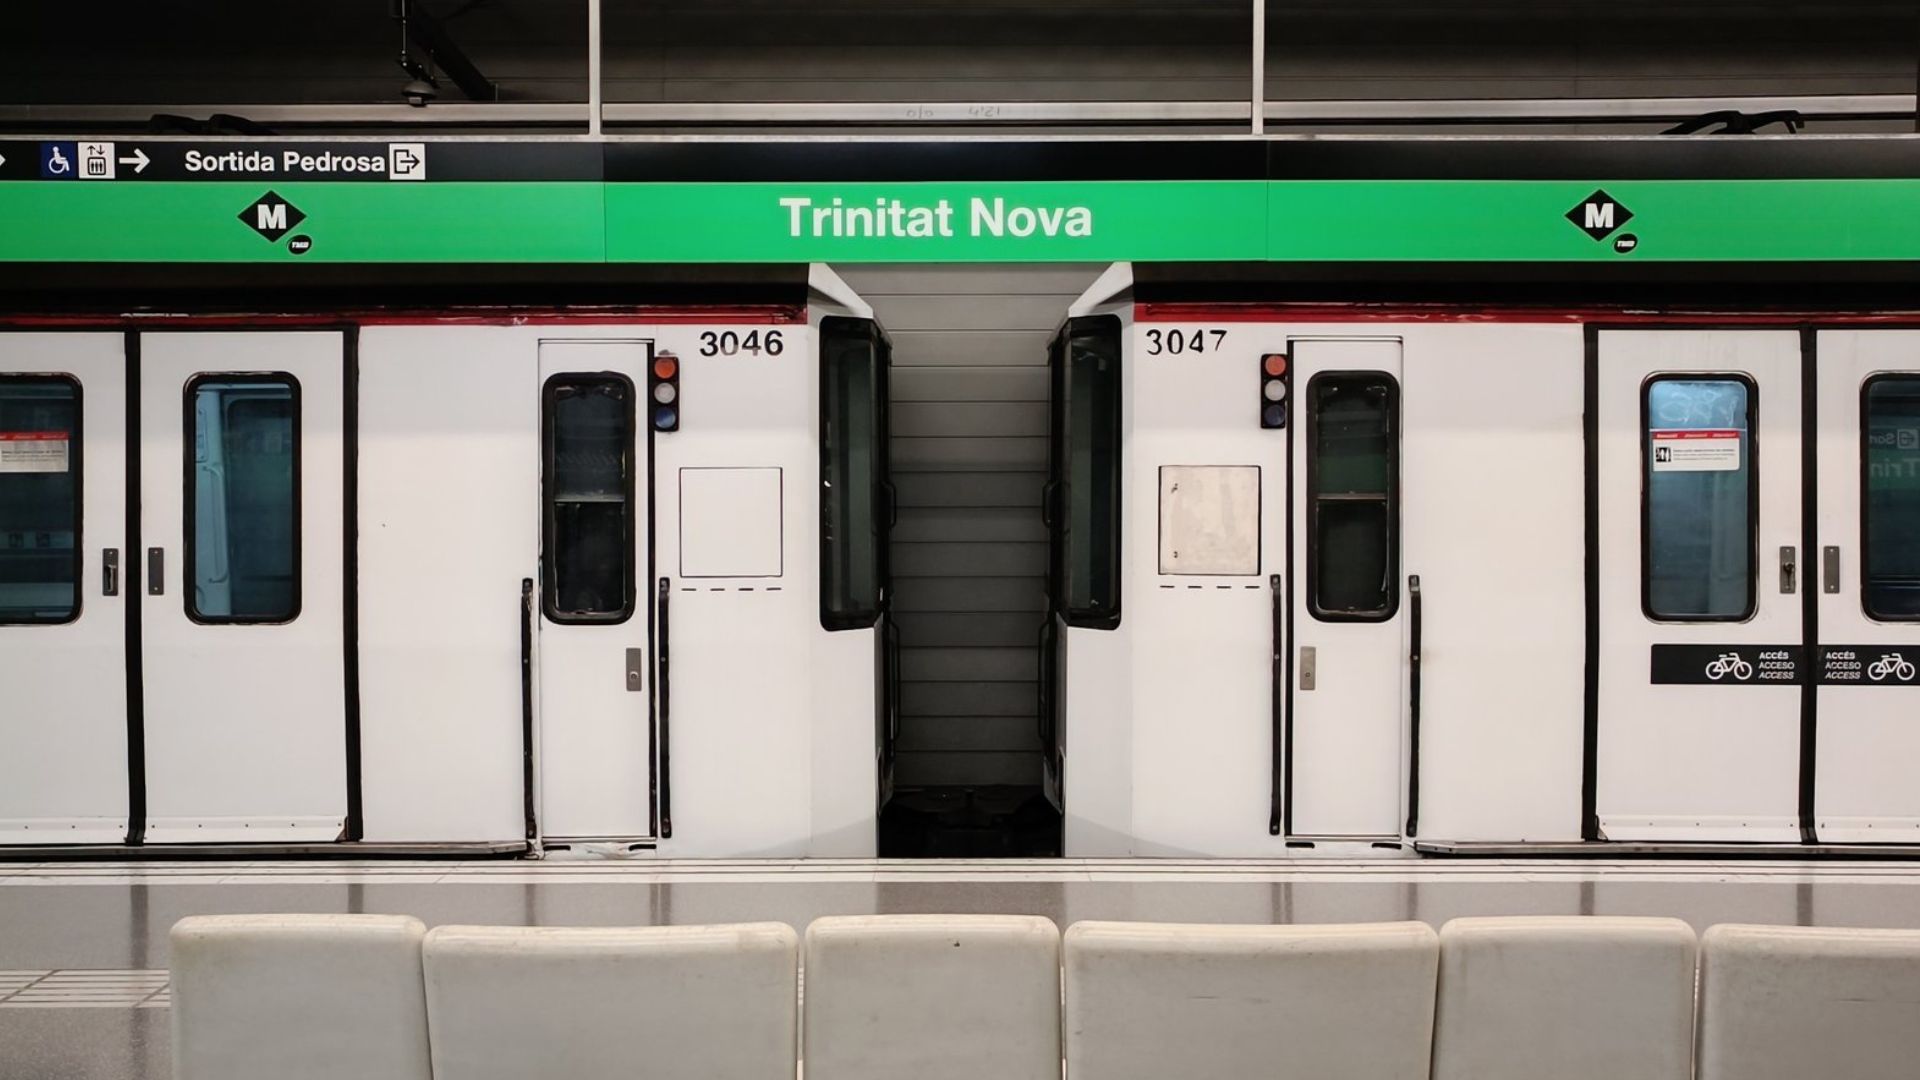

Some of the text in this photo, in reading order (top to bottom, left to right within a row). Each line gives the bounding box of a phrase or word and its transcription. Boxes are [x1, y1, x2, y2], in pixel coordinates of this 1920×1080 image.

[184, 150, 386, 172] Sortida Pedrosa
[257, 204, 287, 230] M
[779, 197, 1092, 237] Trinitat Nova
[1585, 203, 1614, 228] M
[699, 329, 784, 357] 3046
[1146, 328, 1228, 355] 3047
[1758, 661, 1795, 670] ACCESO
[1758, 671, 1795, 680] ACCESS
[1825, 661, 1861, 670] ACCESO
[1825, 671, 1861, 680] ACCESS
